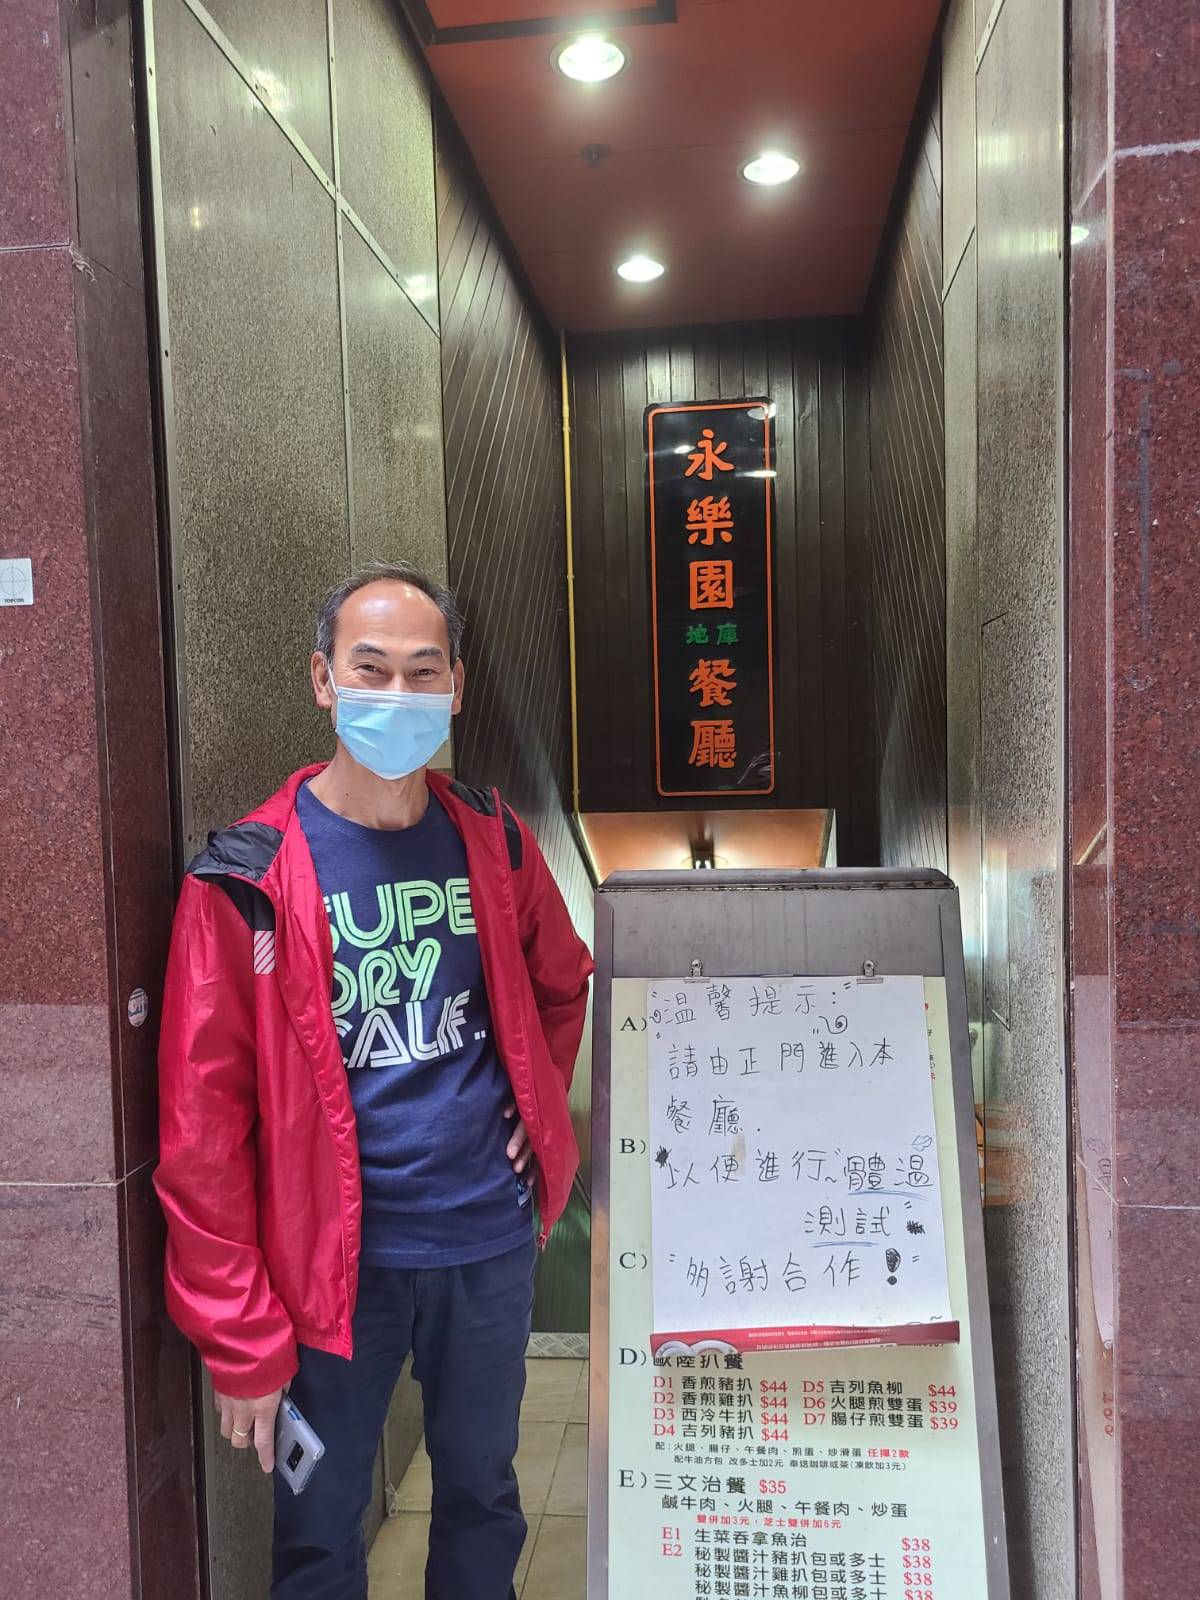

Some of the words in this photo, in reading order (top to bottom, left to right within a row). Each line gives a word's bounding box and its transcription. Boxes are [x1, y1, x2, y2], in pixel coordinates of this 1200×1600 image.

[684, 428, 736, 611] 永樂園
[685, 624, 739, 645] 地庫
[687, 658, 738, 769] 餐廳
[620, 1016, 648, 1032] A)
[620, 1138, 647, 1154] B)
[619, 1252, 648, 1269] C)
[619, 1348, 647, 1366] D)
[653, 1376, 673, 1389] D1
[681, 1376, 753, 1391] 香煎豬扒
[760, 1380, 788, 1393] $44
[803, 1380, 825, 1393] D5
[830, 1380, 903, 1395] 吉列魚柳
[928, 1384, 957, 1397] $44
[653, 1392, 675, 1405] D2
[681, 1392, 753, 1407] 香煎雞扒
[760, 1396, 789, 1409] $44
[803, 1397, 826, 1409] D6
[831, 1396, 923, 1412] 火腿煎雙蛋
[929, 1400, 958, 1413] $39
[653, 1408, 675, 1421] D3
[681, 1408, 754, 1424] 西冷牛扒
[760, 1412, 789, 1425] $44
[804, 1413, 826, 1425] D7
[831, 1412, 924, 1428] 腸仔煎雙蛋
[930, 1416, 959, 1429] $39
[653, 1424, 676, 1436] D4
[681, 1424, 754, 1440] 吉列豬扒
[761, 1428, 790, 1441] $44
[619, 1470, 647, 1489] E)
[654, 1473, 747, 1495] 三文治餐
[759, 1479, 787, 1494] $35
[662, 1527, 681, 1540] E1
[694, 1528, 808, 1548] 生菜吞拿魚治
[901, 1537, 931, 1551] $38
[662, 1543, 682, 1556] E2
[694, 1546, 886, 1568] 秘製醬汁豬扒包或多士
[902, 1554, 931, 1568] $38
[694, 1563, 887, 1585] 秘製醬汁雞扒包或多士
[903, 1571, 933, 1585] $38
